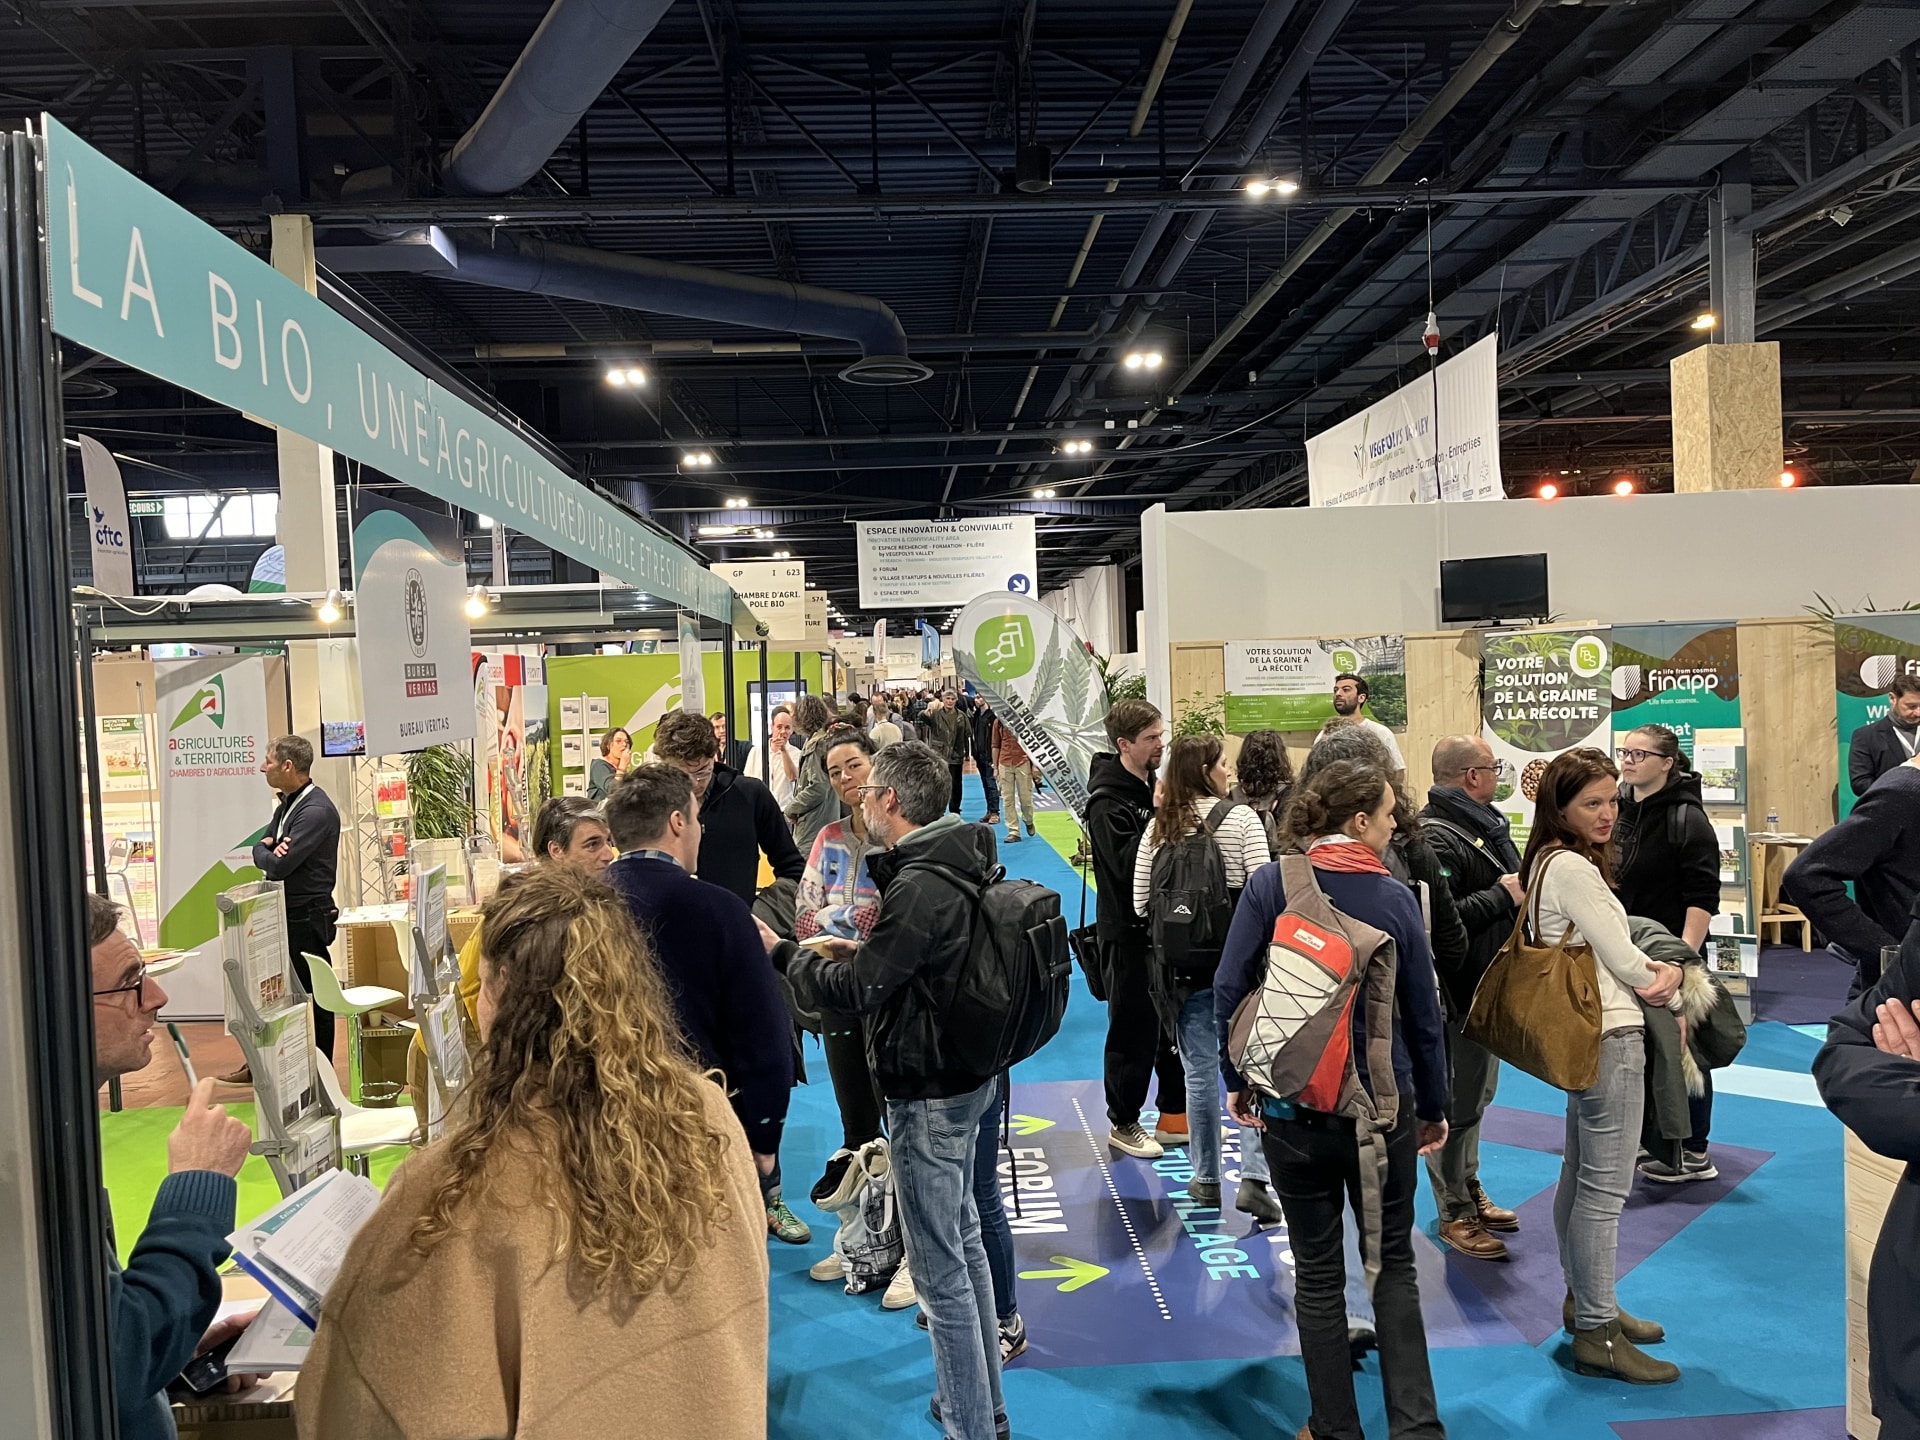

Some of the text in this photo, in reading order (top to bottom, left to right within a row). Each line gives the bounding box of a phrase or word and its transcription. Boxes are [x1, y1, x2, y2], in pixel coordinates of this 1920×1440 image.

[66, 160, 165, 339] LA
[208, 271, 334, 430] BIO,
[356, 362, 430, 467] UNE
[437, 414, 577, 542] AGRICULTURE
[577, 502, 636, 572] DURABLE
[640, 542, 652, 580] ET
[1448, 436, 1481, 459] Entreprises
[128, 502, 155, 513] ECOURS
[96, 524, 123, 547] cftc
[866, 527, 898, 535] ESPACE
[899, 525, 949, 534] INNOVATION
[958, 522, 1014, 532] CONVIVIALITÉ
[786, 568, 801, 576] 623
[733, 591, 801, 599] CHAMBRE D'AGRI.
[770, 600, 785, 608] BIO
[1336, 653, 1354, 670] FBS
[1495, 656, 1544, 670] VOTRE
[1580, 646, 1597, 668] FBS
[406, 665, 435, 677] BUREAU
[1269, 663, 1303, 671] RÉCOLTE
[1494, 671, 1569, 687] SOLUTION
[1648, 669, 1719, 695] finapp
[408, 682, 436, 695] VERITAS
[1494, 688, 1598, 704] DE LA GRAINE
[1492, 703, 1599, 721] À LA RÉCOLTE
[400, 717, 450, 738] BUREAU VERITAS
[174, 751, 256, 765] & TERRITOIRES
[169, 766, 256, 778] CHAMBRES D'AGRICULTURE
[996, 1147, 1069, 1235] FORUM
